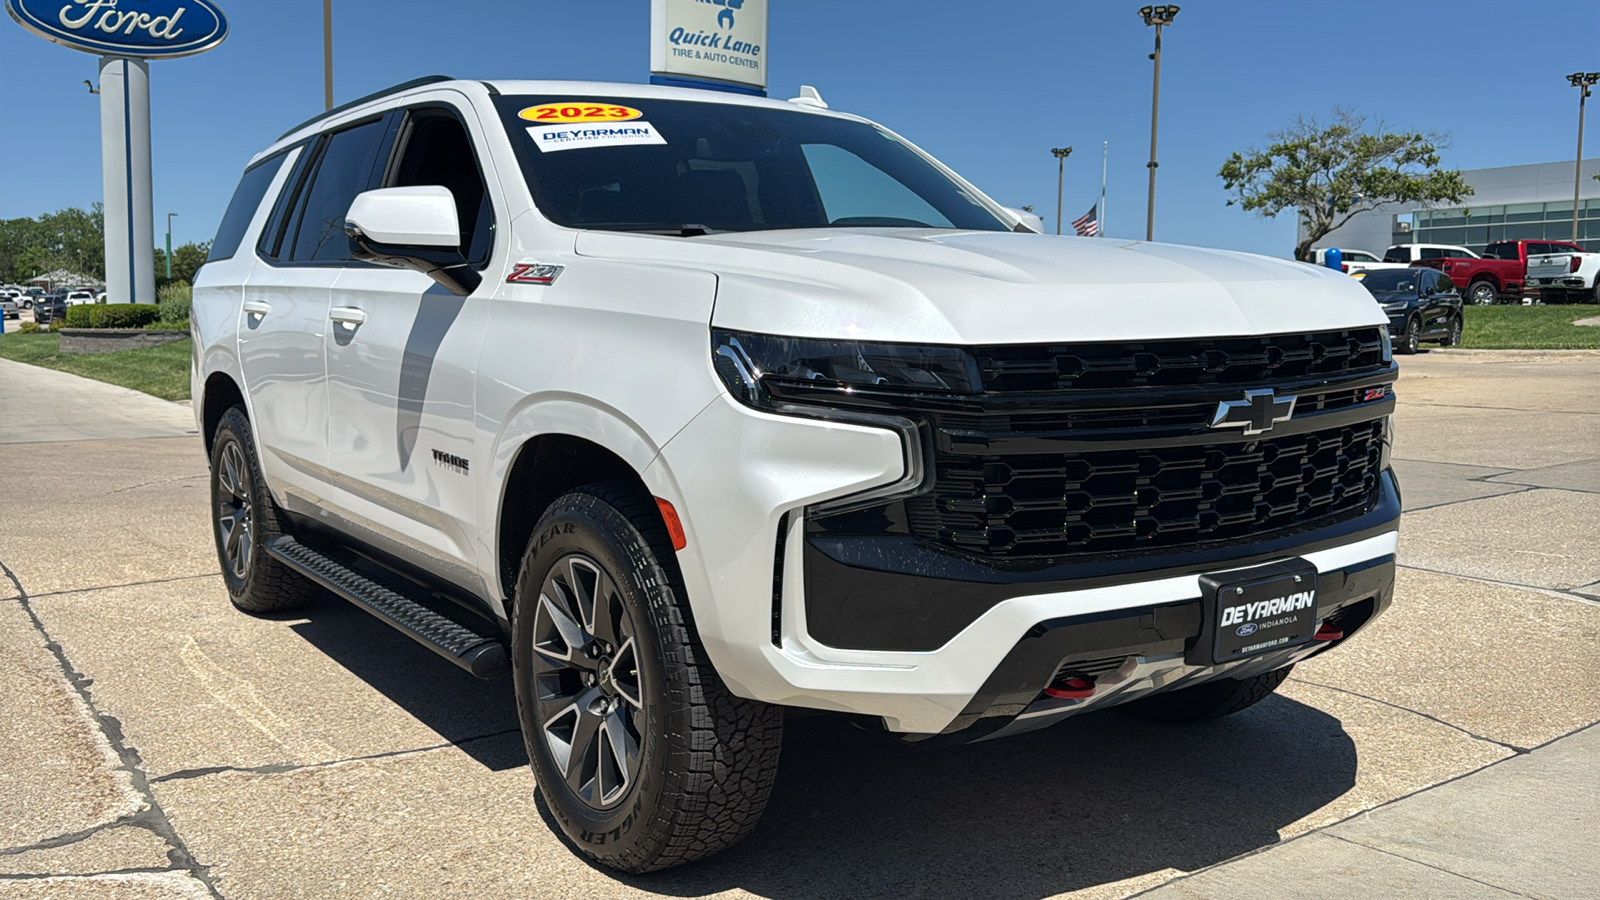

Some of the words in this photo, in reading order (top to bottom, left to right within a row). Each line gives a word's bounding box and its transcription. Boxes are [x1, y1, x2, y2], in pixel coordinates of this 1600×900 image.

[59, 0, 186, 40] Ford
[669, 27, 722, 49] Quick
[722, 35, 761, 56] Lane
[672, 48, 693, 59] TIRE
[694, 50, 702, 60] &
[703, 52, 727, 63] AUTO
[729, 55, 759, 70] CENTER
[536, 107, 631, 119] 2023
[543, 128, 649, 141] DEYARMAN
[431, 448, 470, 471] TAHOE
[1220, 590, 1316, 628] DEYARMAN
[1259, 615, 1298, 630] INDIANOLA
[1241, 636, 1289, 653] DEYARMANFORD.COM
